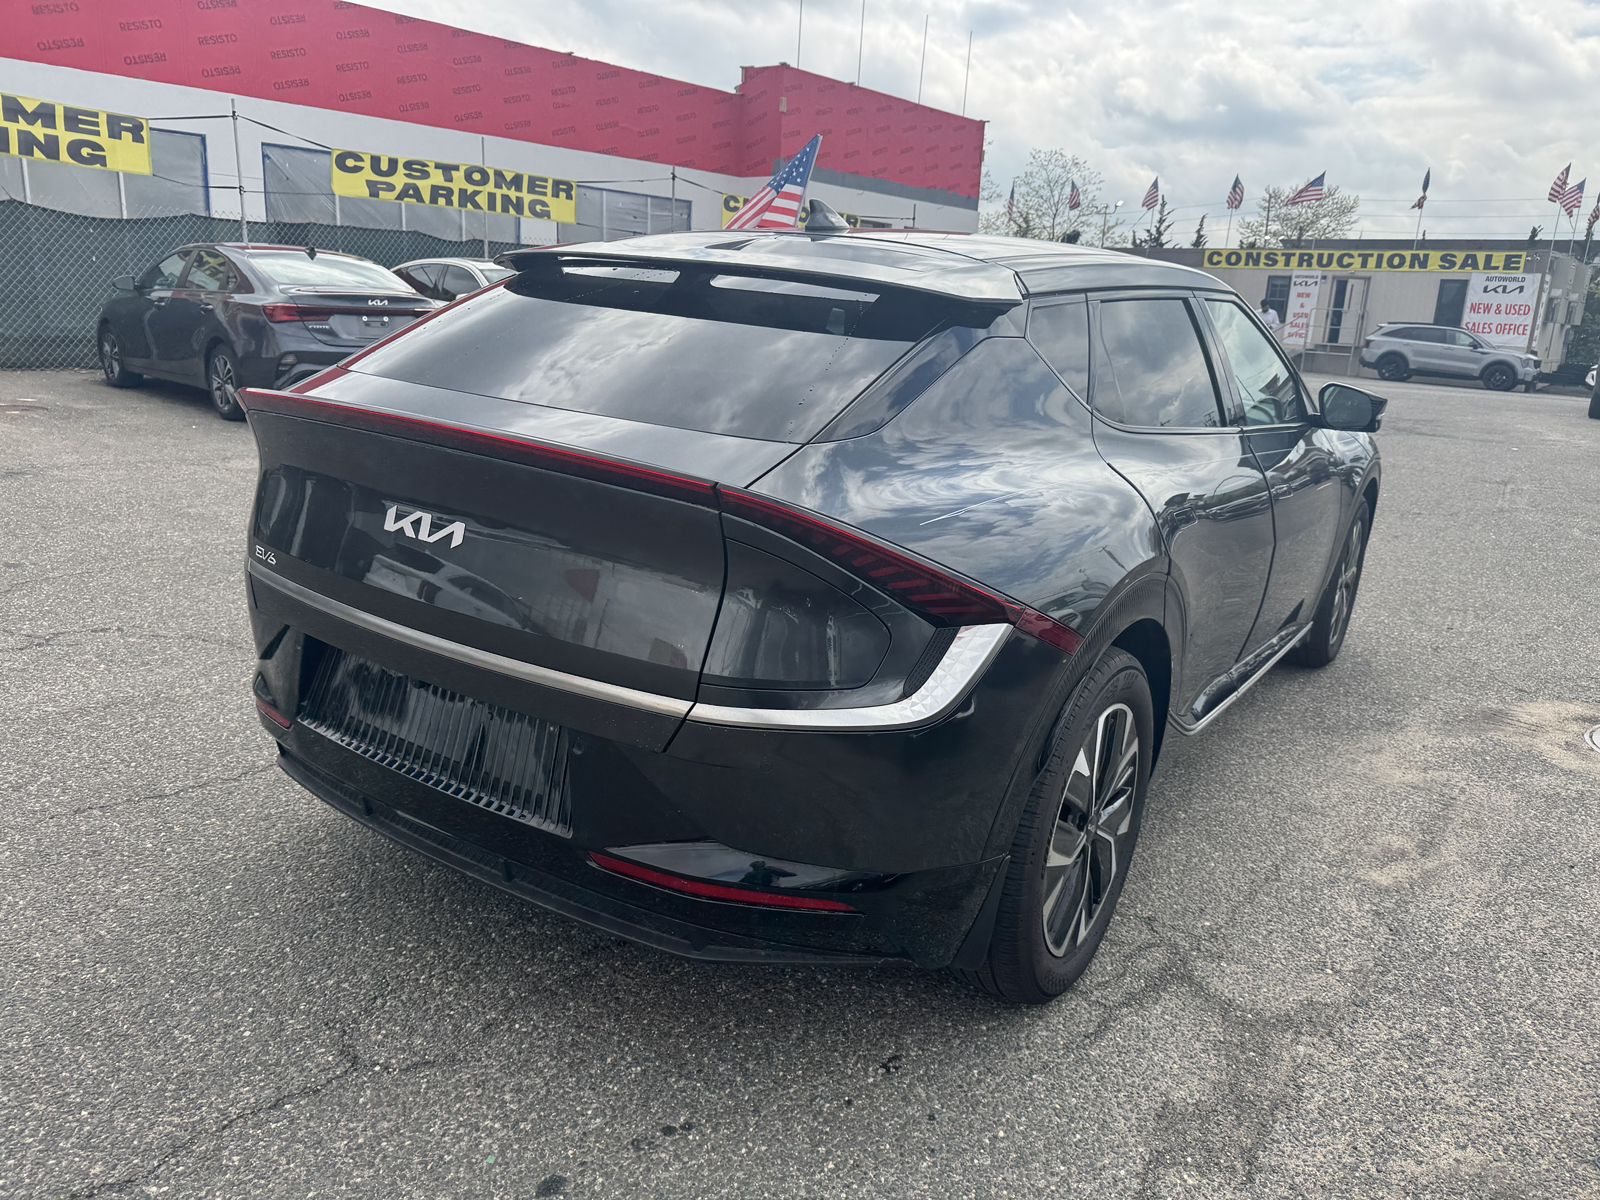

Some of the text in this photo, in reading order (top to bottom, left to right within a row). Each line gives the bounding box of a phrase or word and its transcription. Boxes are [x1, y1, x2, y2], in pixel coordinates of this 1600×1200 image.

[32, 2, 79, 15] RESISTO
[119, 19, 162, 32] RESISTO
[270, 14, 306, 26] RESISTO
[197, 33, 238, 46] RESISTO
[336, 29, 370, 40] RESISTO
[37, 38, 85, 51] RESISTO
[397, 43, 428, 54] RESISTO
[124, 52, 167, 66] RESISTO
[270, 47, 307, 60] RESISTO
[202, 65, 242, 78] RESISTO
[336, 61, 370, 73] RESISTO
[273, 78, 310, 91] RESISTO
[396, 73, 428, 85] RESISTO
[338, 90, 372, 102] RESISTO
[452, 84, 482, 95] RESISTO
[503, 94, 531, 105] RESISTO
[399, 101, 430, 113] RESISTO
[1, 94, 145, 144] MER
[454, 111, 483, 122] RESISTO
[504, 120, 532, 131] RESISTO
[334, 151, 574, 201] CUSTOMER
[366, 179, 551, 219] PARKING
[1207, 251, 1523, 271] CONSTRUCTION SALE
[1485, 275, 1526, 283] AUTOWORLD
[1469, 302, 1531, 316] NEW & USED
[1465, 321, 1529, 336] SALES OFFICE
[383, 504, 466, 549] KIA
[255, 544, 277, 566] EV6
